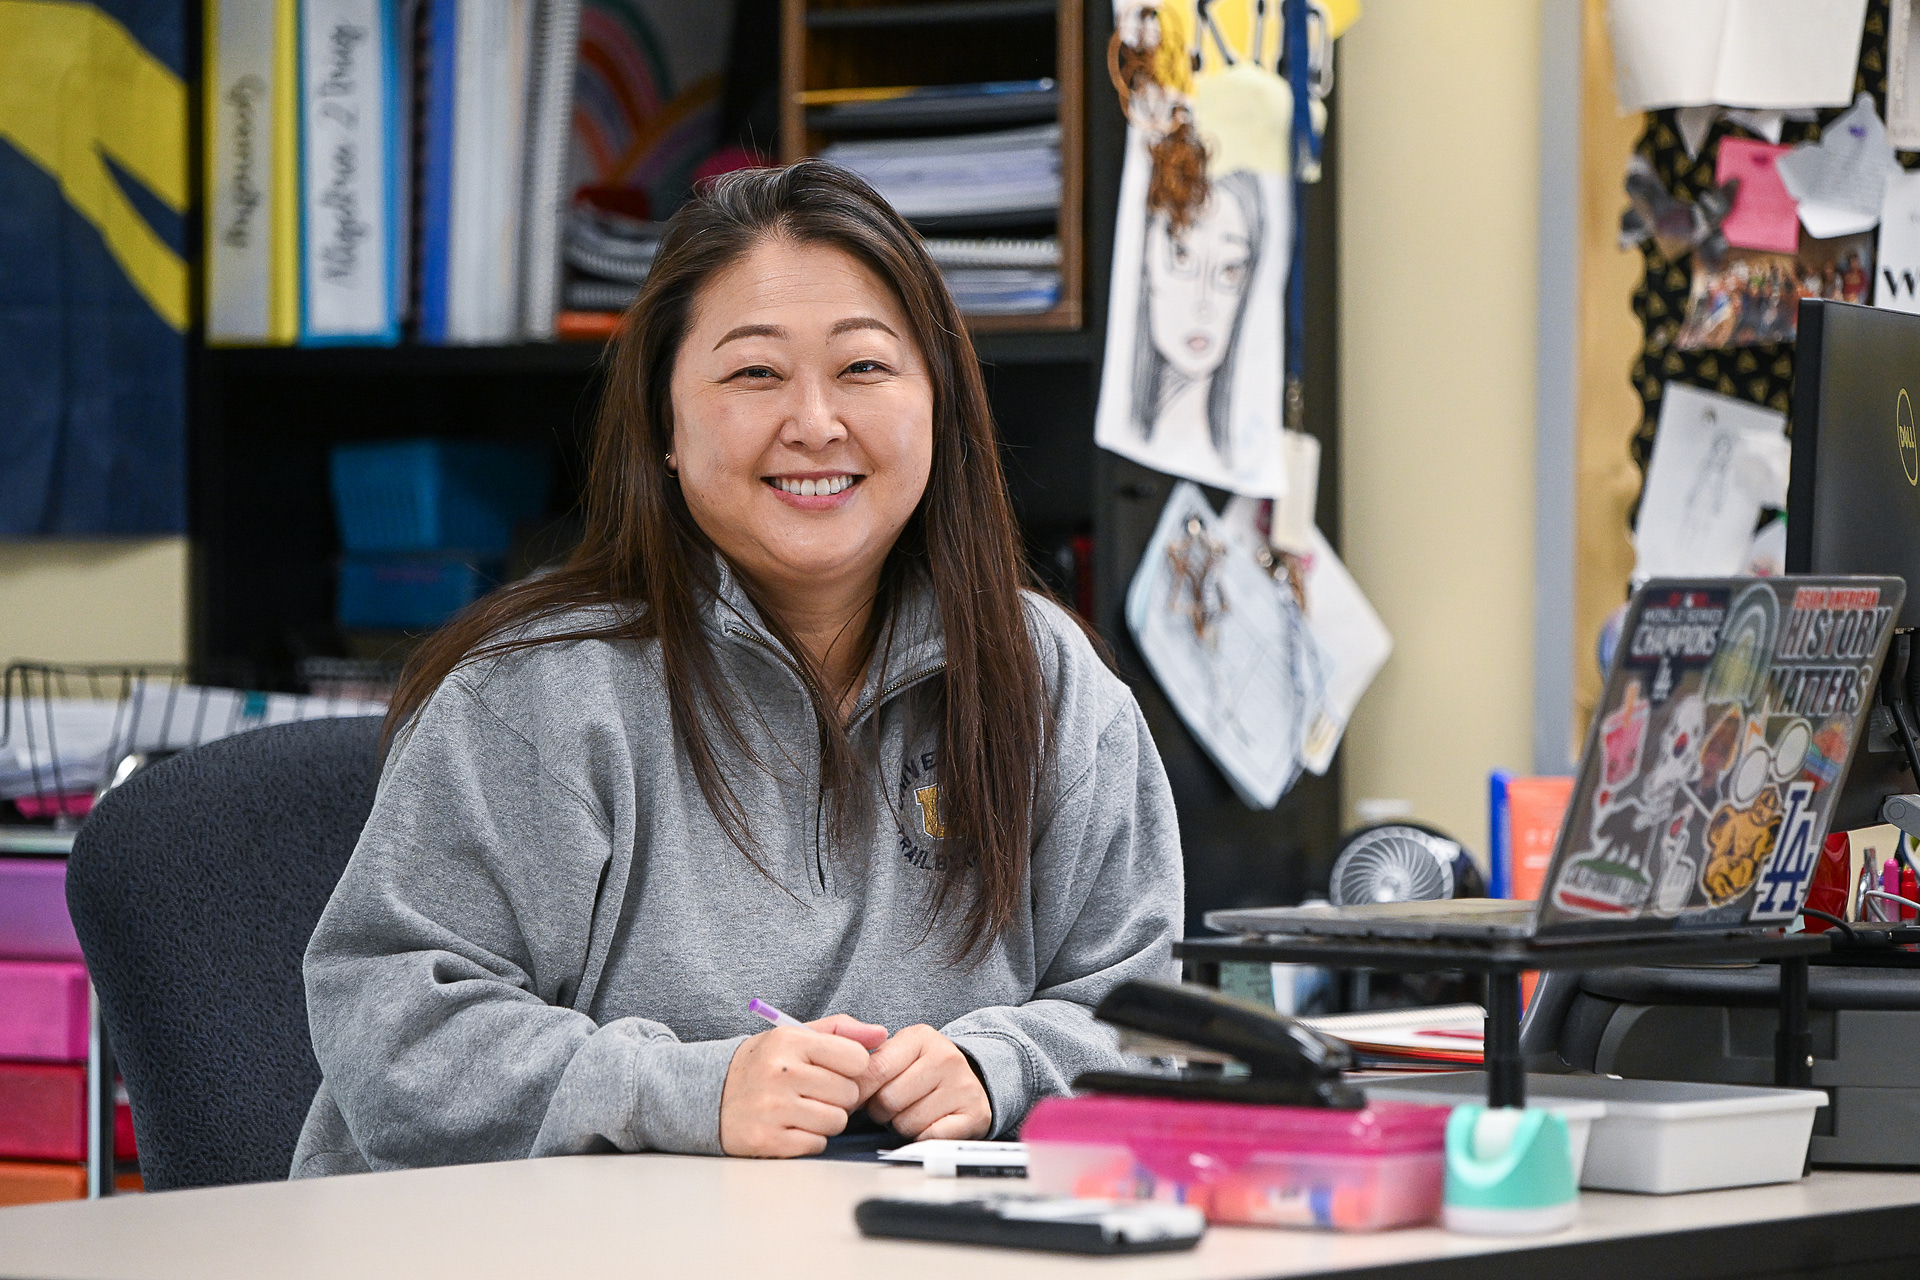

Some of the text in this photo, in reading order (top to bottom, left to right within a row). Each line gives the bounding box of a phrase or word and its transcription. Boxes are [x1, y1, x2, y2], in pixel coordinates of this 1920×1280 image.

[317, 143, 371, 287] Algebra
[1899, 424, 1915, 449] DELL
[1780, 606, 1893, 658] HISTORY
[1766, 665, 1873, 717] MATTERS
[1757, 789, 1815, 912] LA
